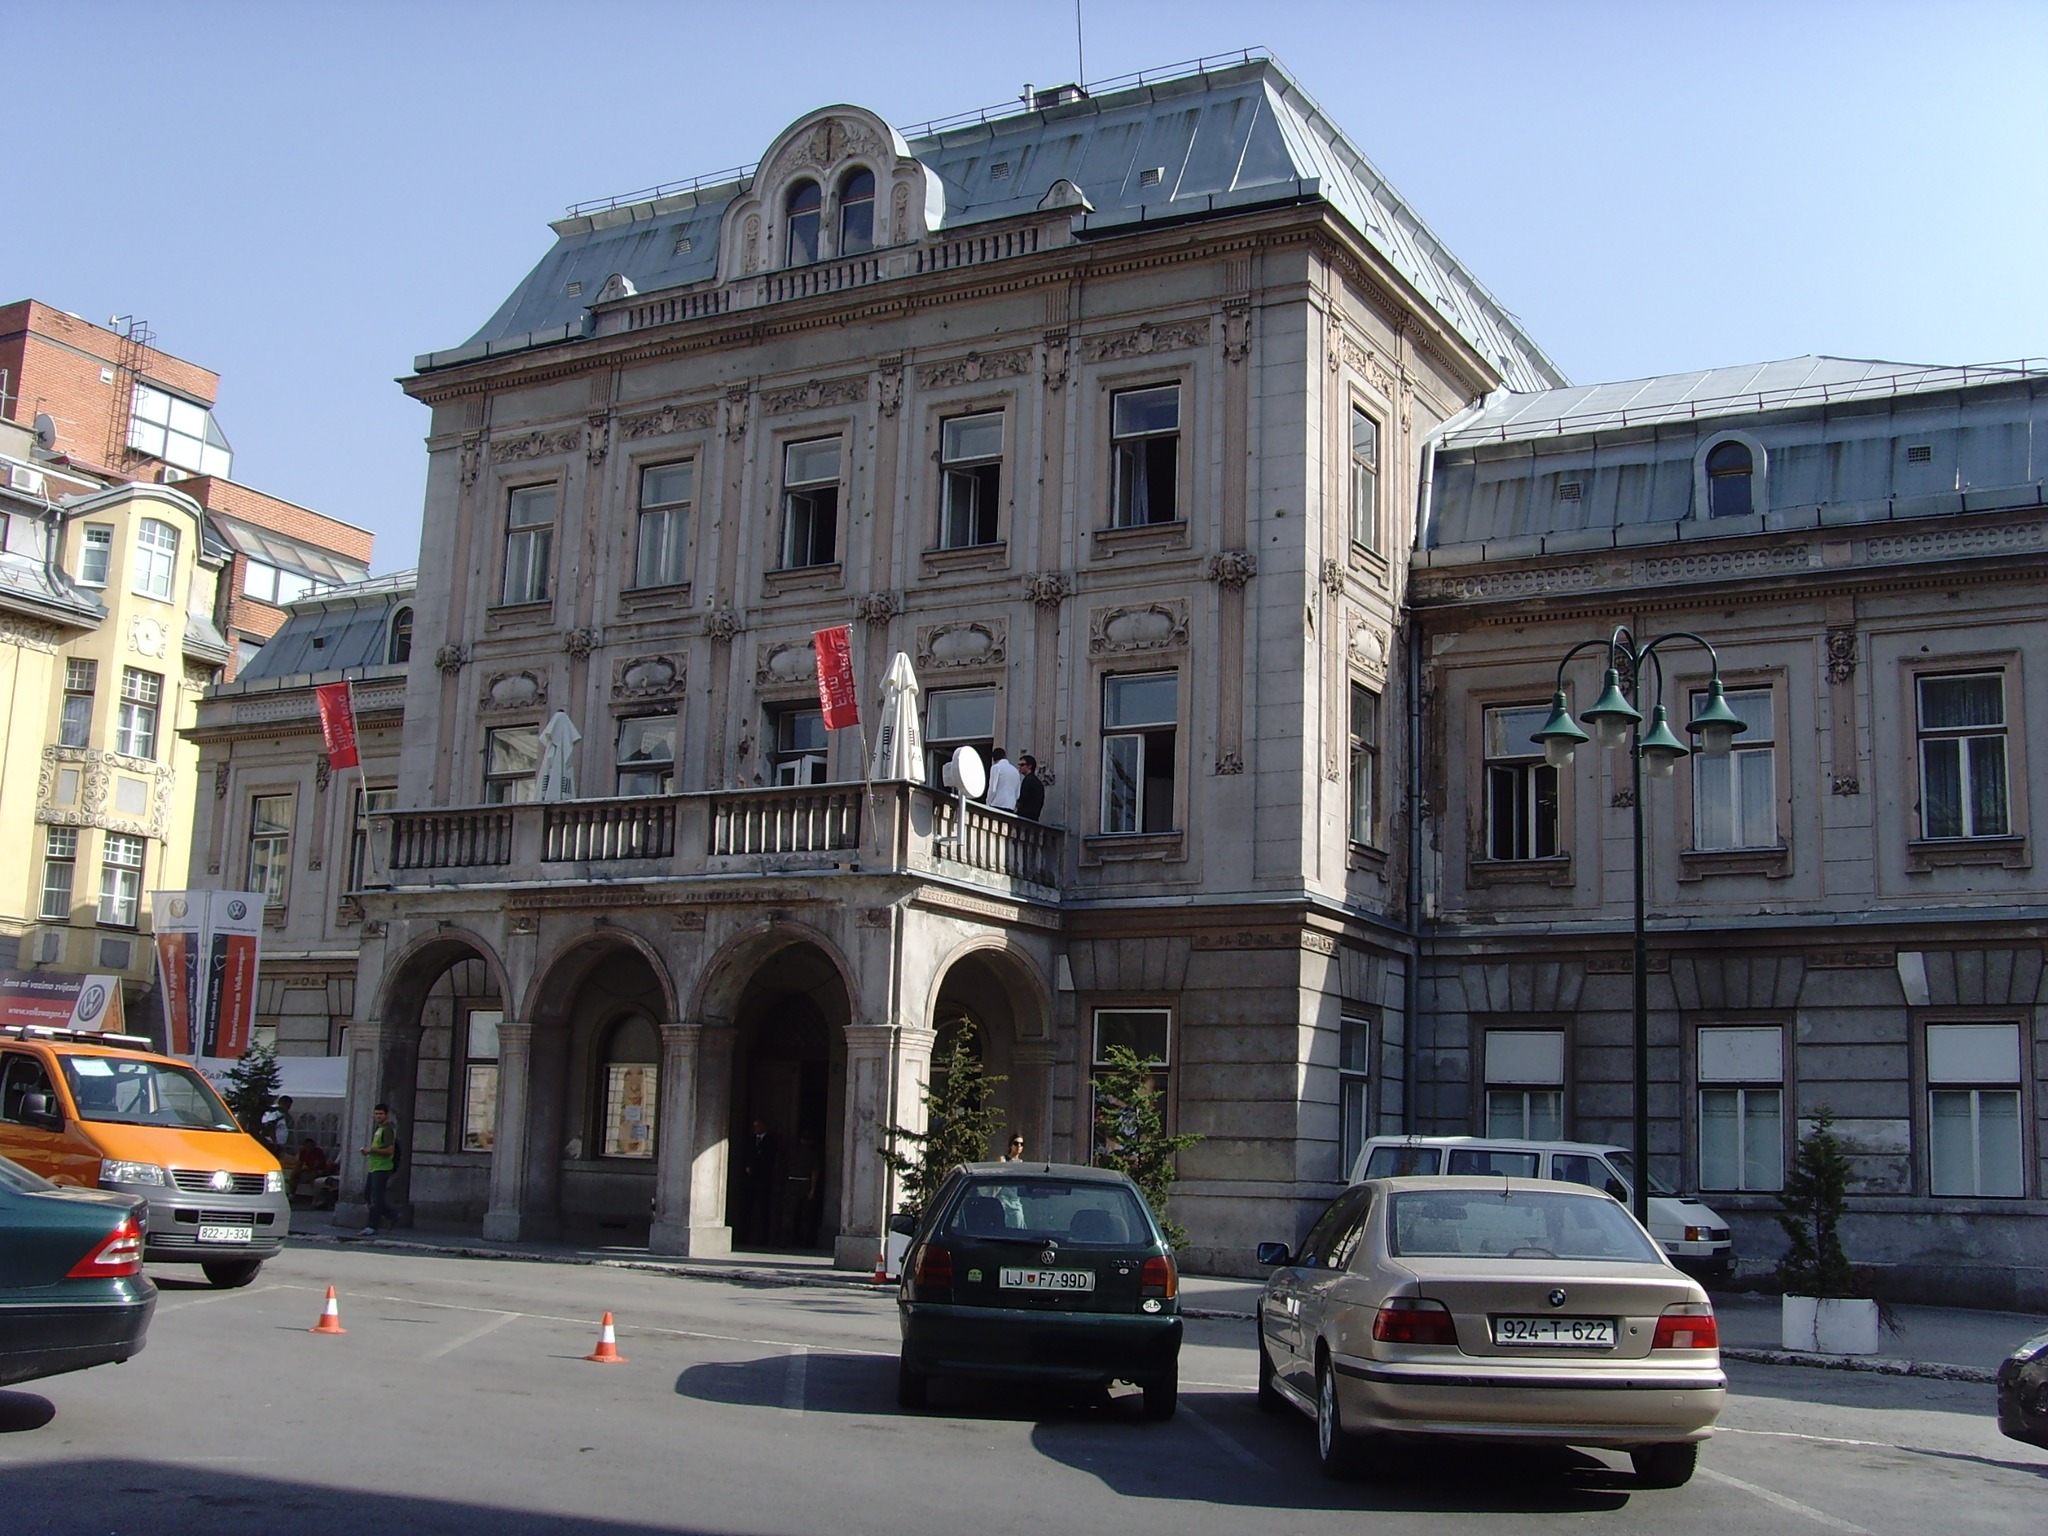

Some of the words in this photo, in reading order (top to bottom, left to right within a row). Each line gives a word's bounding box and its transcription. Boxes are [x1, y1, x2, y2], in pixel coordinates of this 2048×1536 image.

[201, 1227, 250, 1240] 822-J-334
[1006, 1271, 1023, 1286] LJ
[1038, 1272, 1088, 1289] F7-99D
[1503, 1320, 1608, 1342] 924-T-622
